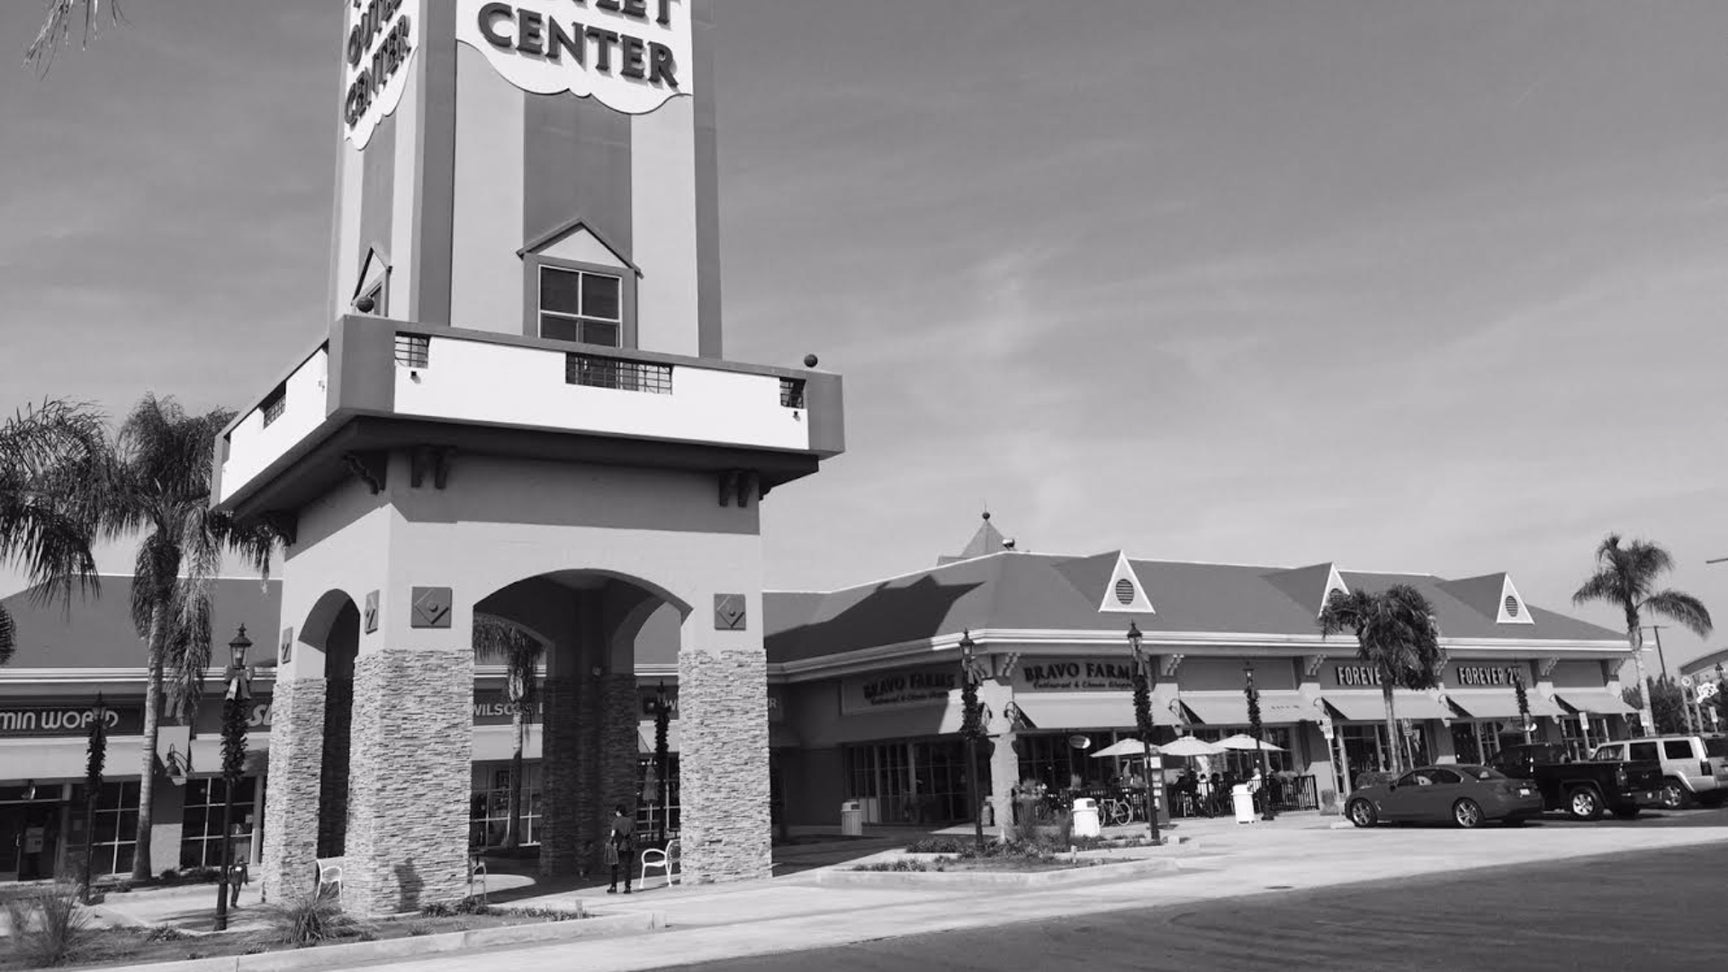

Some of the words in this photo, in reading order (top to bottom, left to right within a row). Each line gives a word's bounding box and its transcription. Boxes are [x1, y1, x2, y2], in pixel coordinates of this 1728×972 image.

[478, 2, 678, 88] CENTER
[345, 14, 411, 128] CENTER
[1023, 662, 1080, 682] BRAVO
[1085, 662, 1136, 680] FARM
[1337, 667, 1384, 685] FOREVE
[1459, 667, 1504, 685] FOREVER
